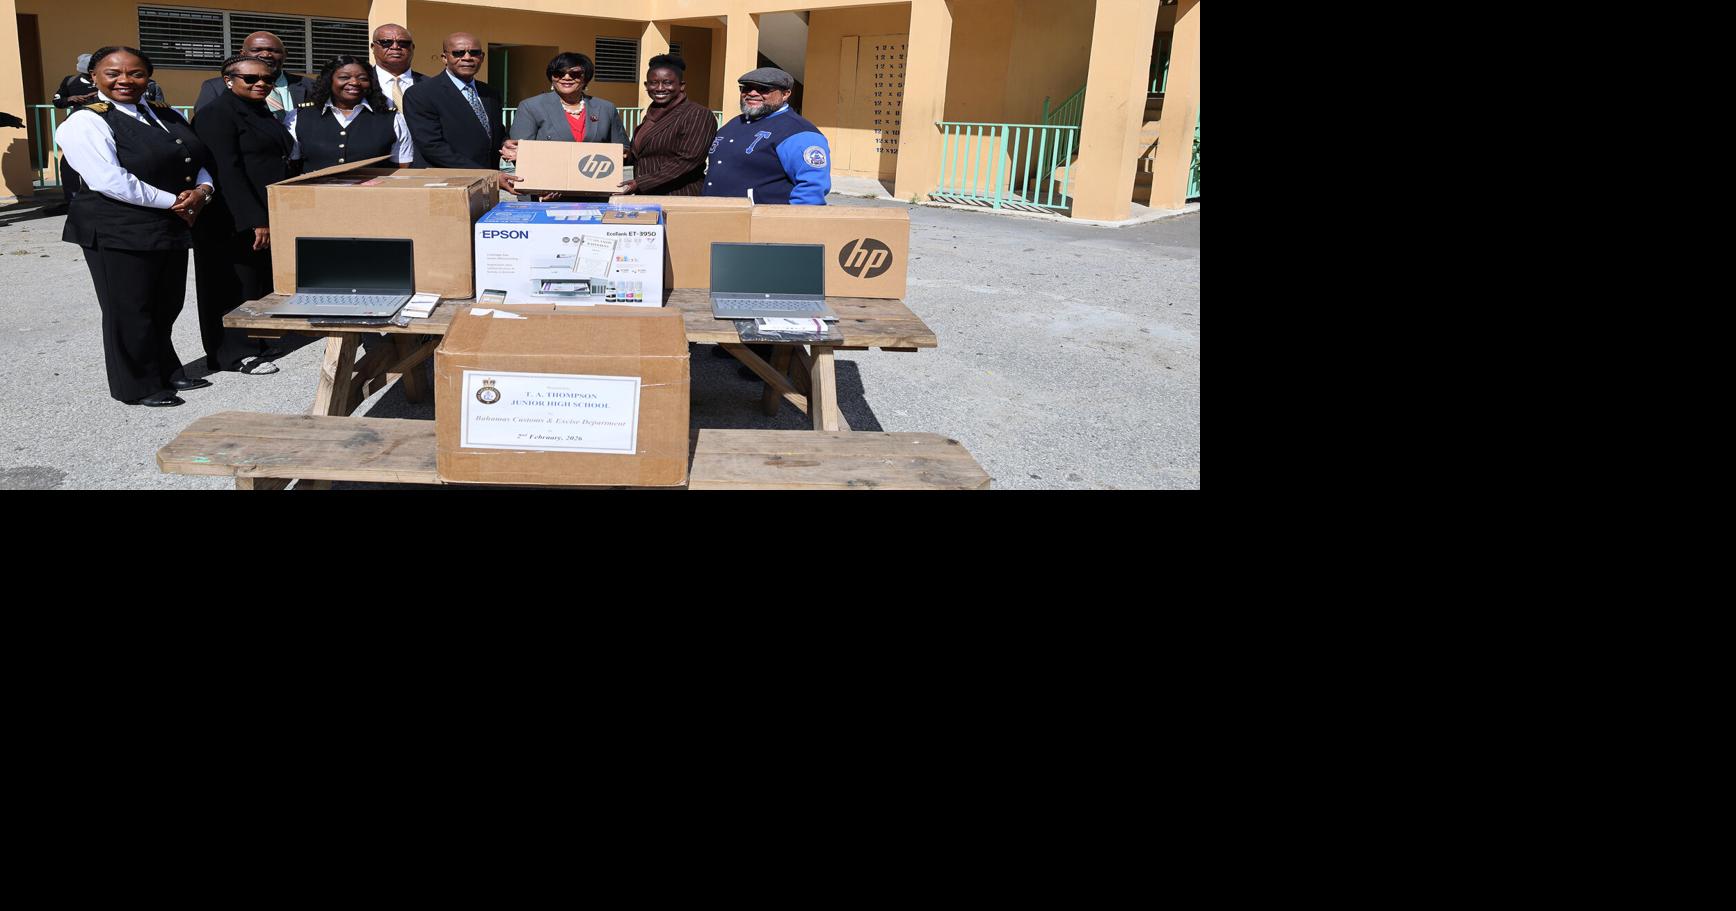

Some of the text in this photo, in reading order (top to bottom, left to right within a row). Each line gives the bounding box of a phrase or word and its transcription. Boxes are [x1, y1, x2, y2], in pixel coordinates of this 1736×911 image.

[746, 130, 771, 154] T
[580, 154, 613, 179] hp
[482, 230, 529, 239] EPSON
[841, 238, 890, 278] hp
